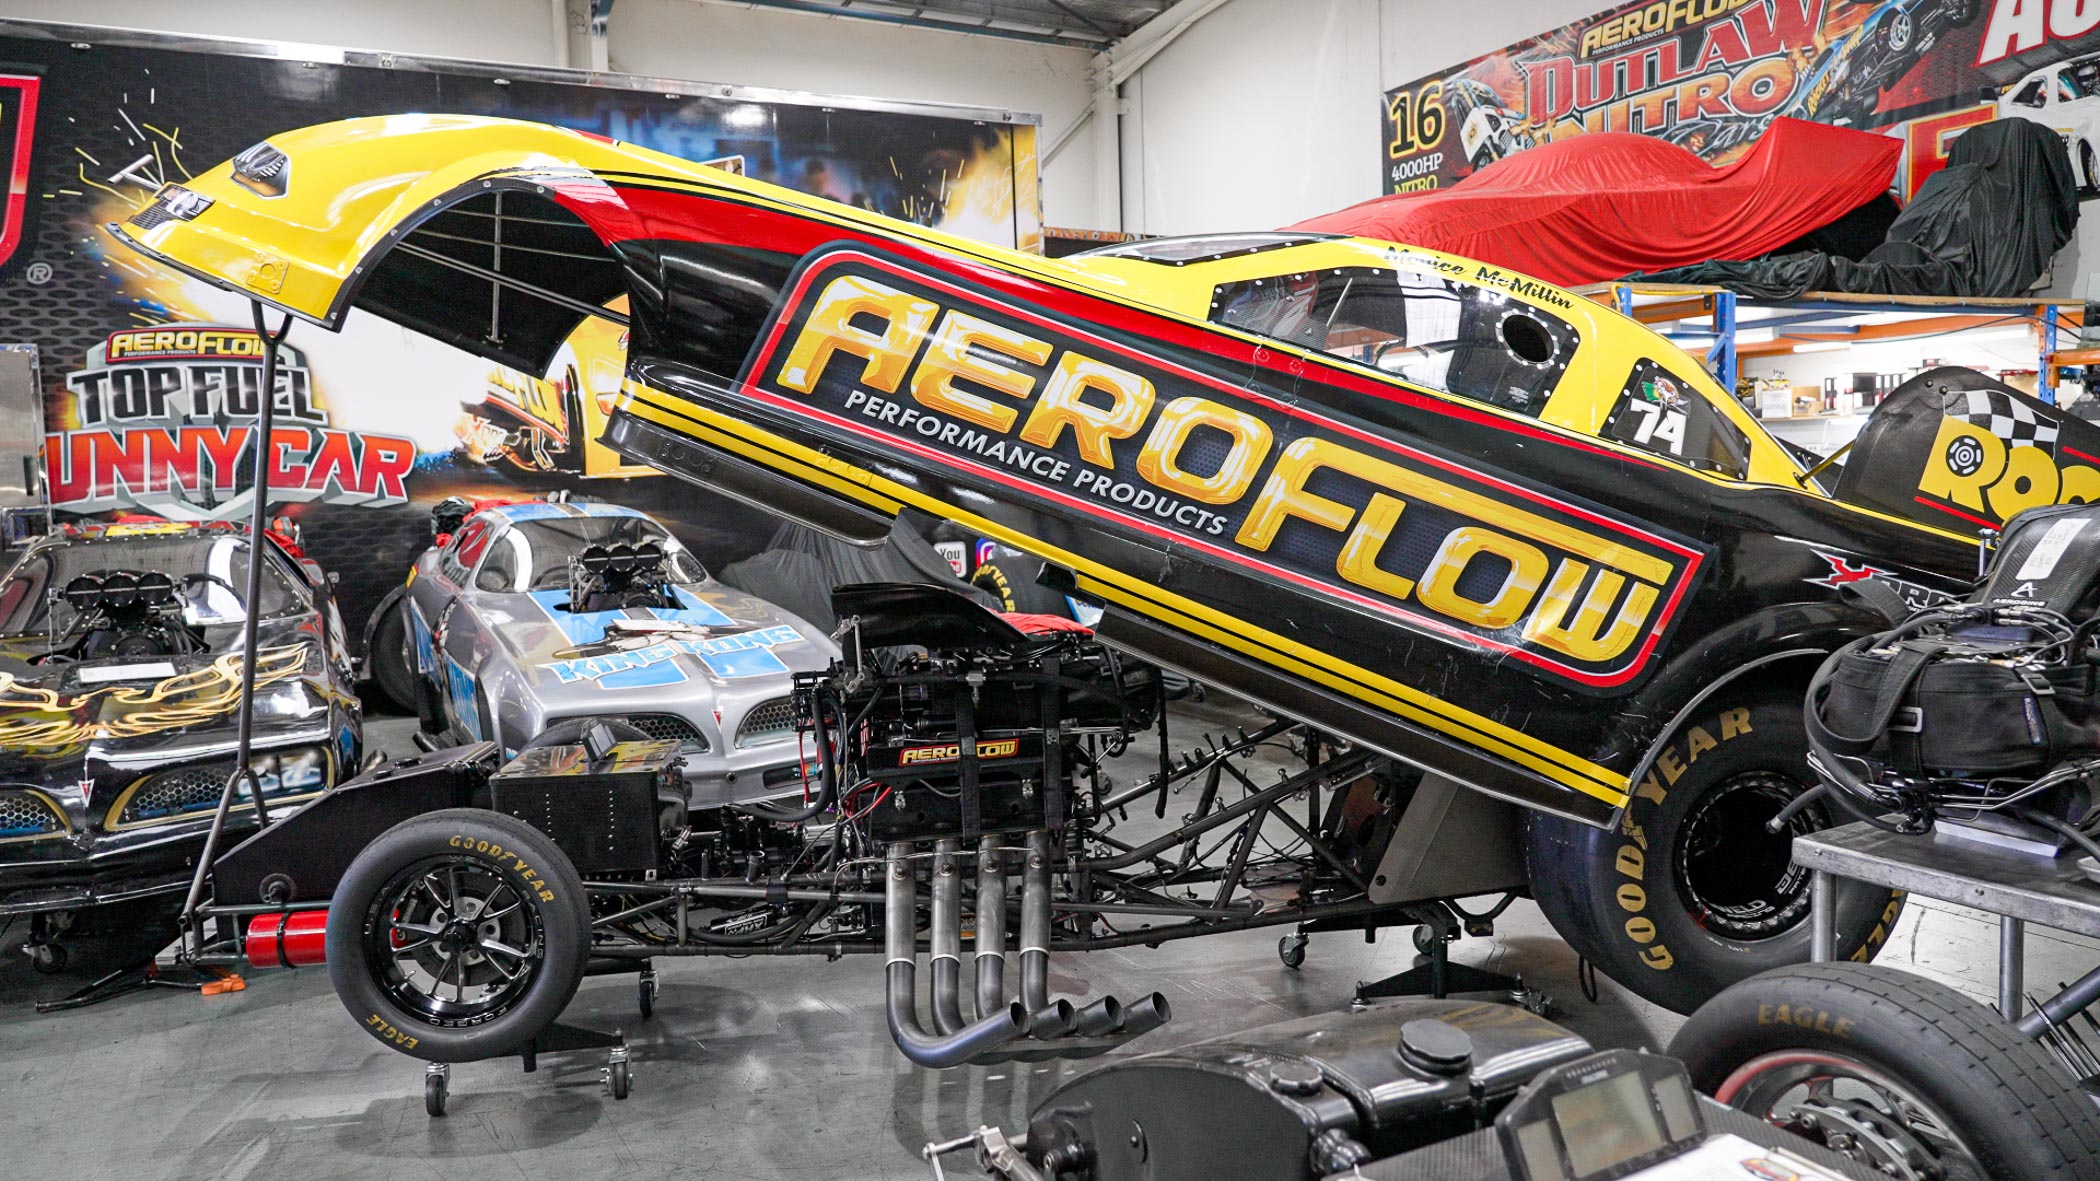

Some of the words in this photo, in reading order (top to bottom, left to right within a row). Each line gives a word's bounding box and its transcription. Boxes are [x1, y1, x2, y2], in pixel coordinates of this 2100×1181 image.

[1592, 38, 1633, 55] PERFORMANCE
[1634, 29, 1665, 43] PRODUCTS
[1390, 81, 1446, 158] 16
[1391, 153, 1443, 181] 4000HP
[1394, 175, 1438, 195] NITRO
[70, 366, 183, 422] TOP
[187, 363, 327, 425] FUEL
[1630, 398, 1687, 456] 74
[262, 428, 416, 500] CAR
[776, 275, 1674, 663] AEROFLOW
[844, 389, 1068, 482] PERFORMANCE
[1072, 468, 1229, 536] PRODUCTS
[902, 741, 1015, 764] AEROLOW
[1616, 706, 1752, 970] GOODYEAR
[449, 834, 555, 903] GOODYEAR
[367, 1014, 420, 1050] EAGLE
[429, 1007, 508, 1028] FORGED
[1758, 1003, 1857, 1039] EAGLE
